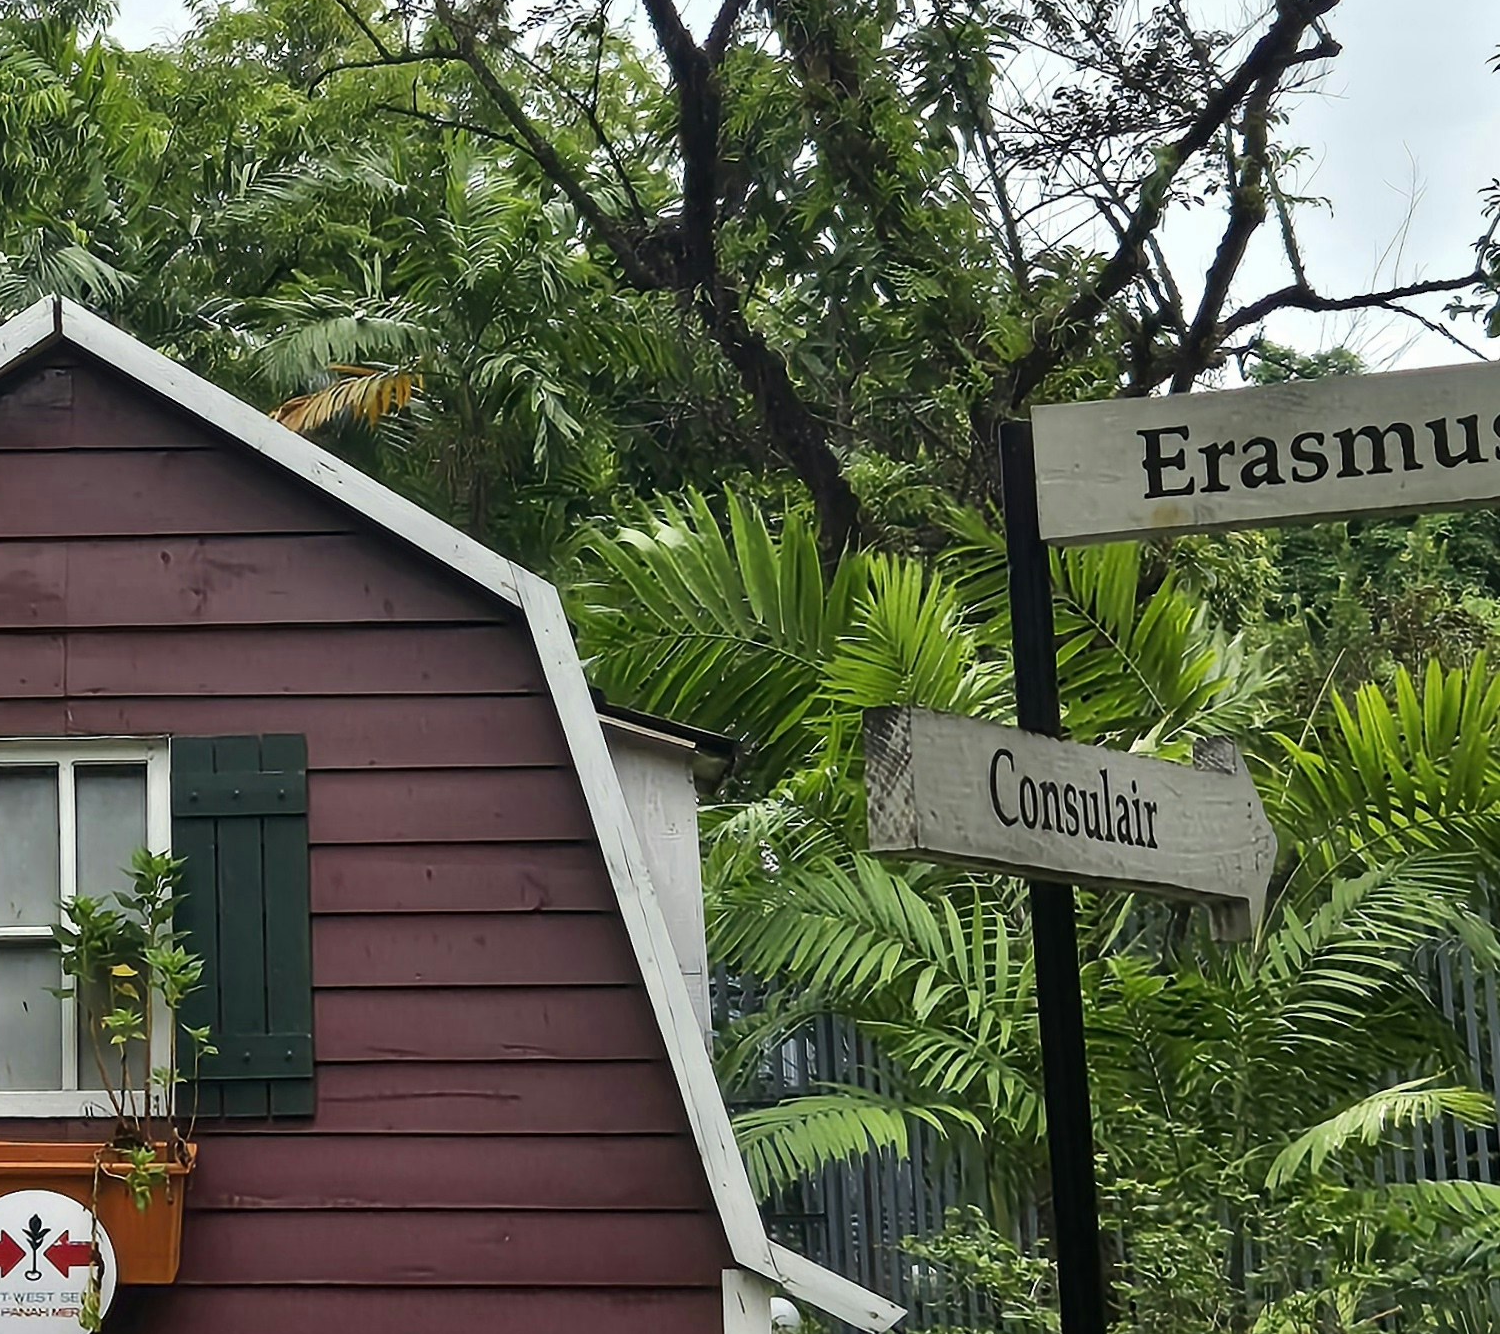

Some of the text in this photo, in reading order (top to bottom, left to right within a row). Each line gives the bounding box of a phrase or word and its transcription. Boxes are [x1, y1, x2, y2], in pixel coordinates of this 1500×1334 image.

[1136, 414, 1500, 499] Erasmu
[989, 748, 1158, 849] Consulair
[51, 1307, 80, 1317] MER
[60, 1292, 79, 1303] SE
